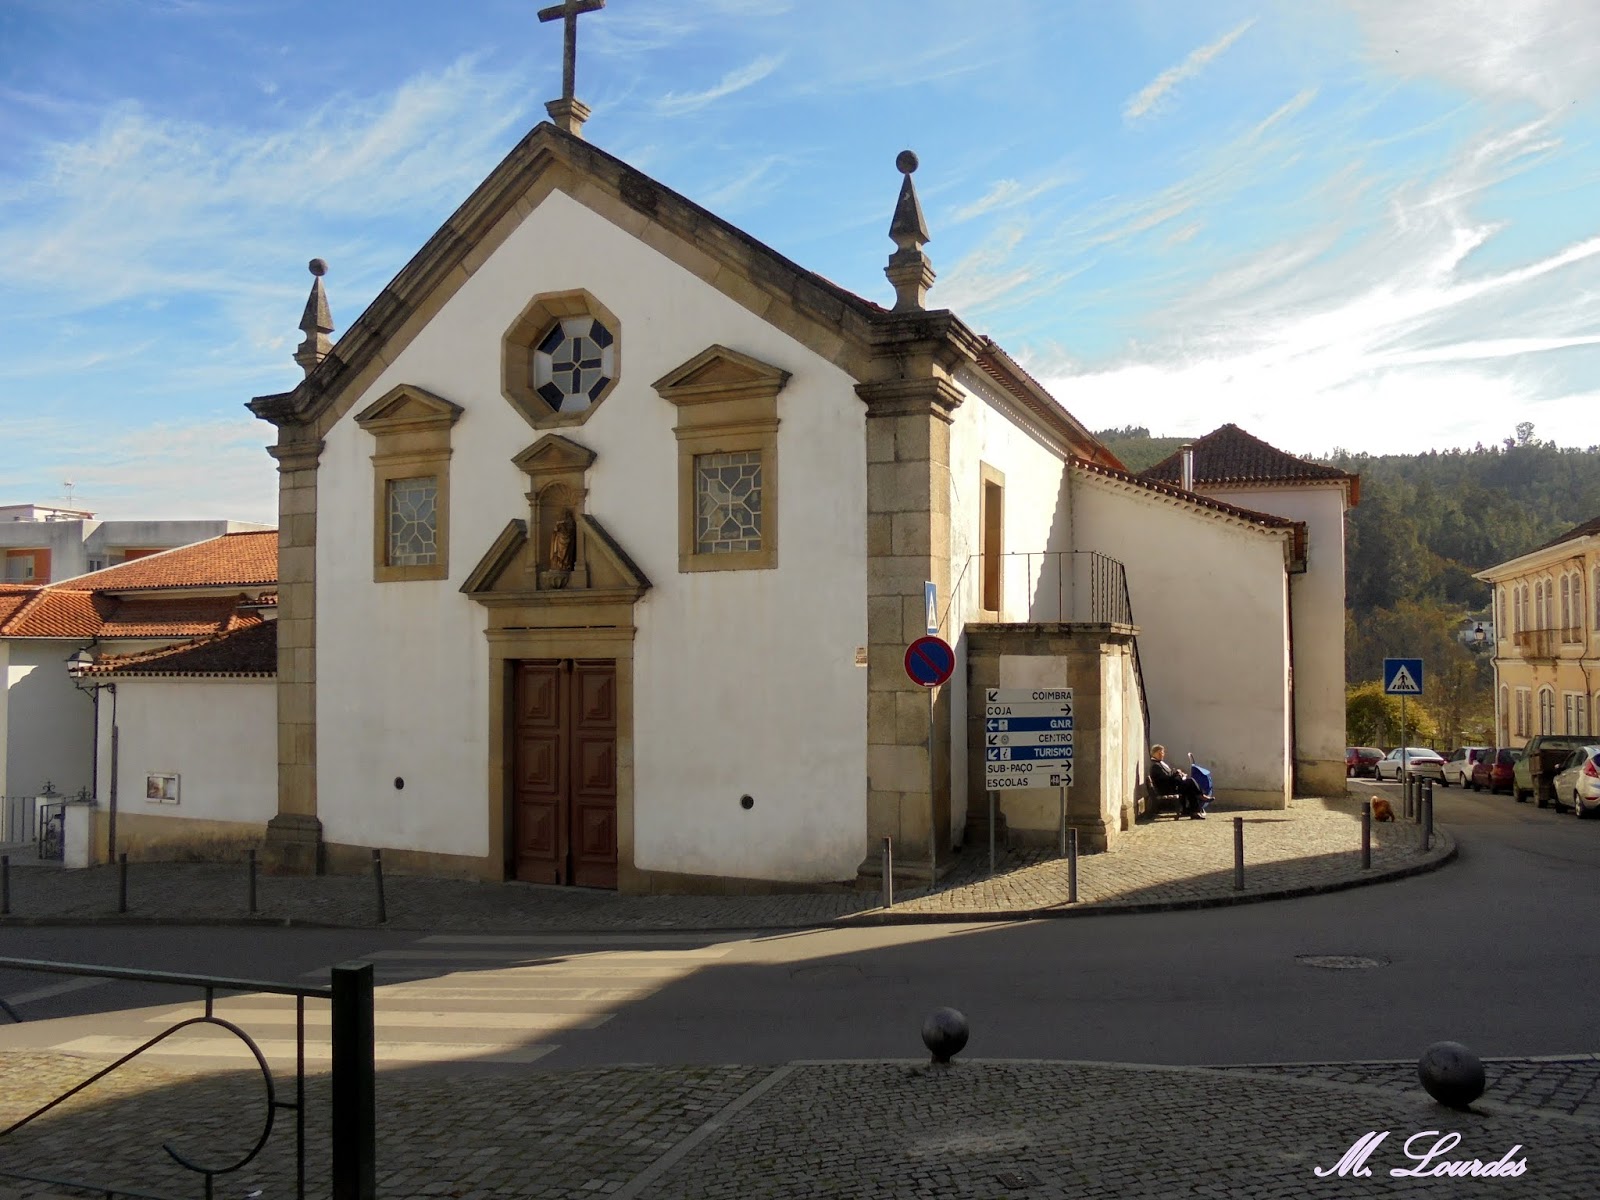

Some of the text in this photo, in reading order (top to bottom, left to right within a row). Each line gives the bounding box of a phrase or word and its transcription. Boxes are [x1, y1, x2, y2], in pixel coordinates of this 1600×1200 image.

[1032, 691, 1072, 700] COIMBRA
[987, 706, 1012, 715] COJA
[1038, 733, 1072, 742] CENTRO
[1033, 748, 1072, 757] TURISMO
[987, 763, 1033, 774] SUB-PAÇO
[987, 778, 1029, 788] ESCOLAS
